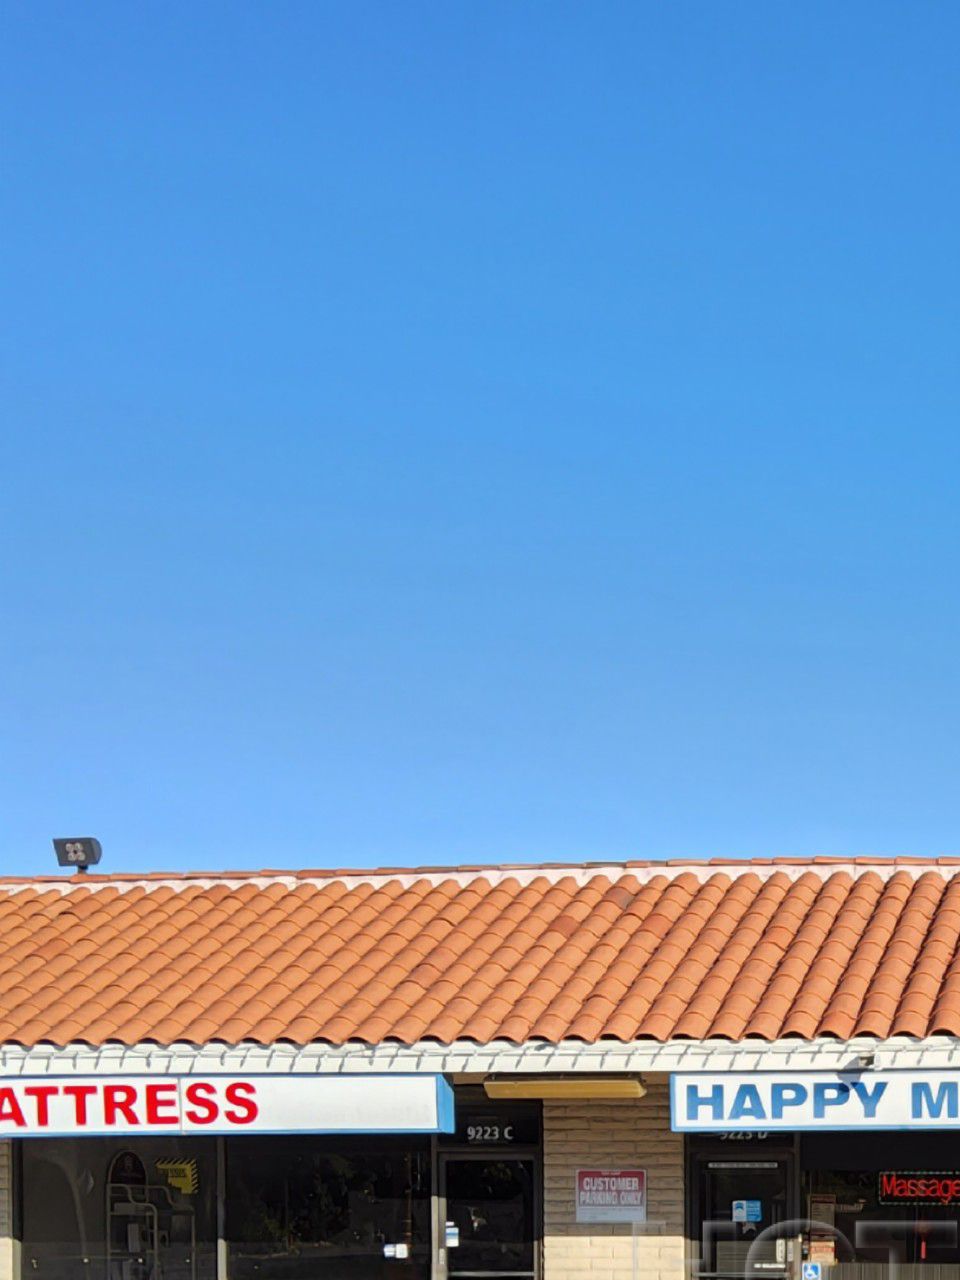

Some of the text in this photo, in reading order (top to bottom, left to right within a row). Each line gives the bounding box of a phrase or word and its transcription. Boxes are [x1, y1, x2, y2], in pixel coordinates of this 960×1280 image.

[0, 1082, 258, 1127] ATTRESS
[686, 1082, 886, 1121] HAPPY
[467, 1126, 513, 1140] 9223 C
[583, 1177, 639, 1190] CUSTOMER
[580, 1191, 642, 1205] PARKING ONLY
